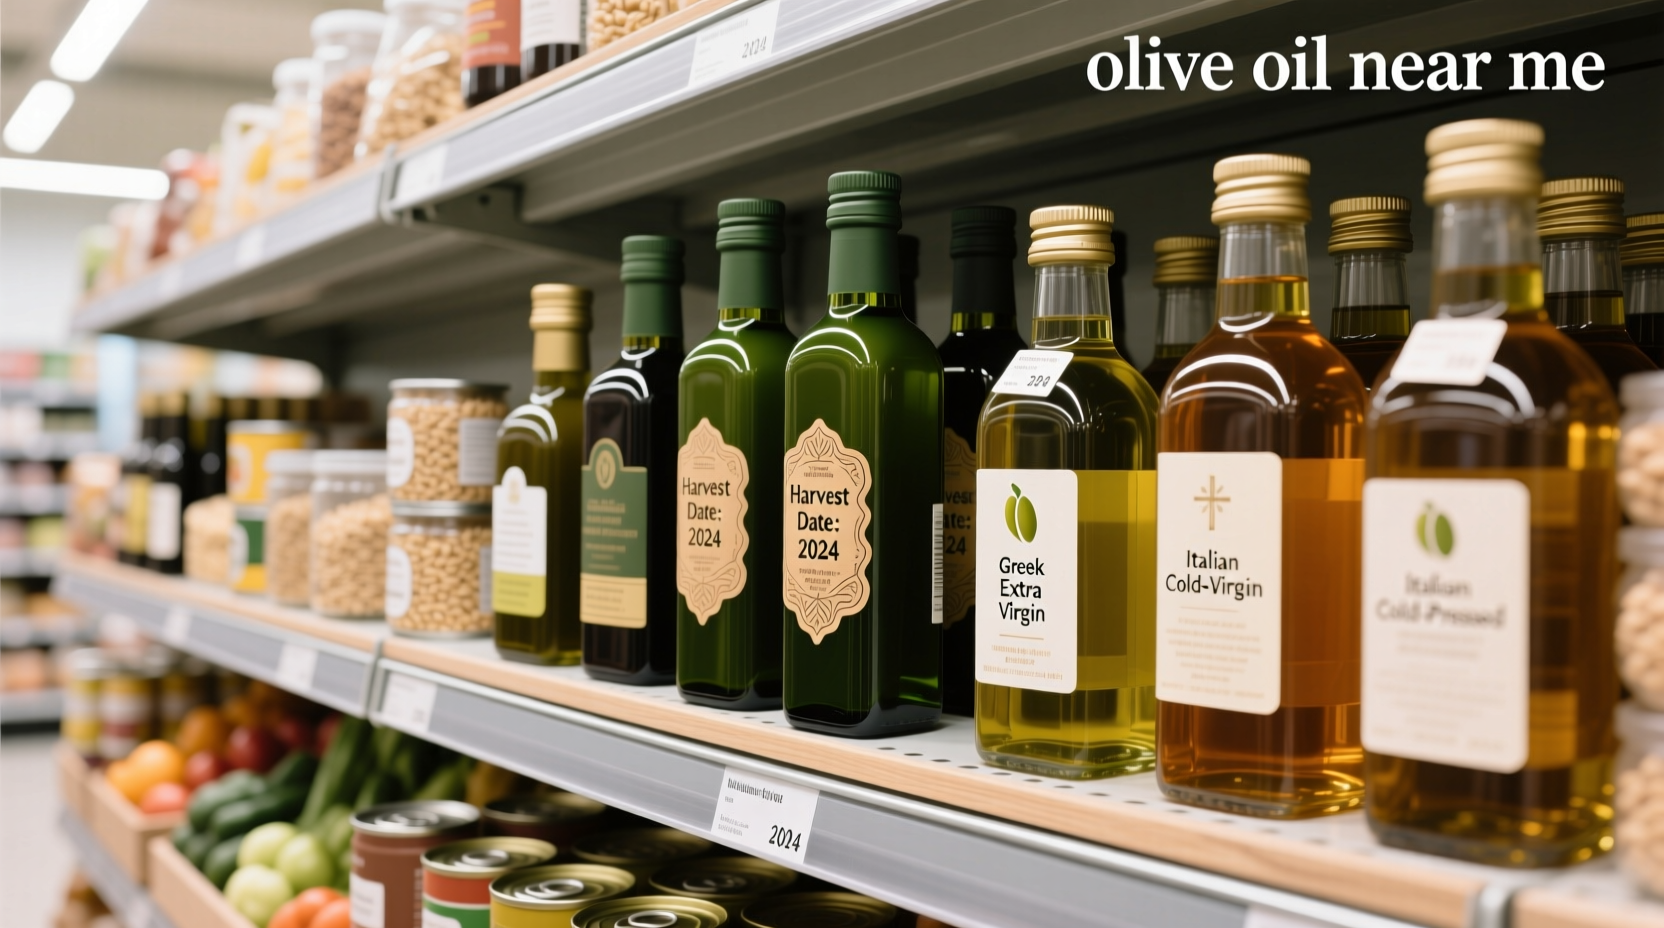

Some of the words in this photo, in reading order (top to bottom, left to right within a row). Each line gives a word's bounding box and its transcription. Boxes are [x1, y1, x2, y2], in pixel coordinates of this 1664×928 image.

[682, 476, 731, 497] Harvest
[790, 484, 850, 506] Harvest
[945, 490, 974, 505] vest
[687, 501, 722, 523] Date:
[797, 511, 840, 533] Date:
[687, 527, 722, 548] 2024
[944, 535, 968, 556] 24
[798, 538, 840, 562] 2024
[1185, 548, 1240, 571] Italian
[998, 556, 1045, 577] Greek
[999, 578, 1042, 600] Extra
[1165, 573, 1264, 602] Cold-Virgin
[998, 601, 1046, 627] Virgin
[768, 824, 802, 853] 2024
